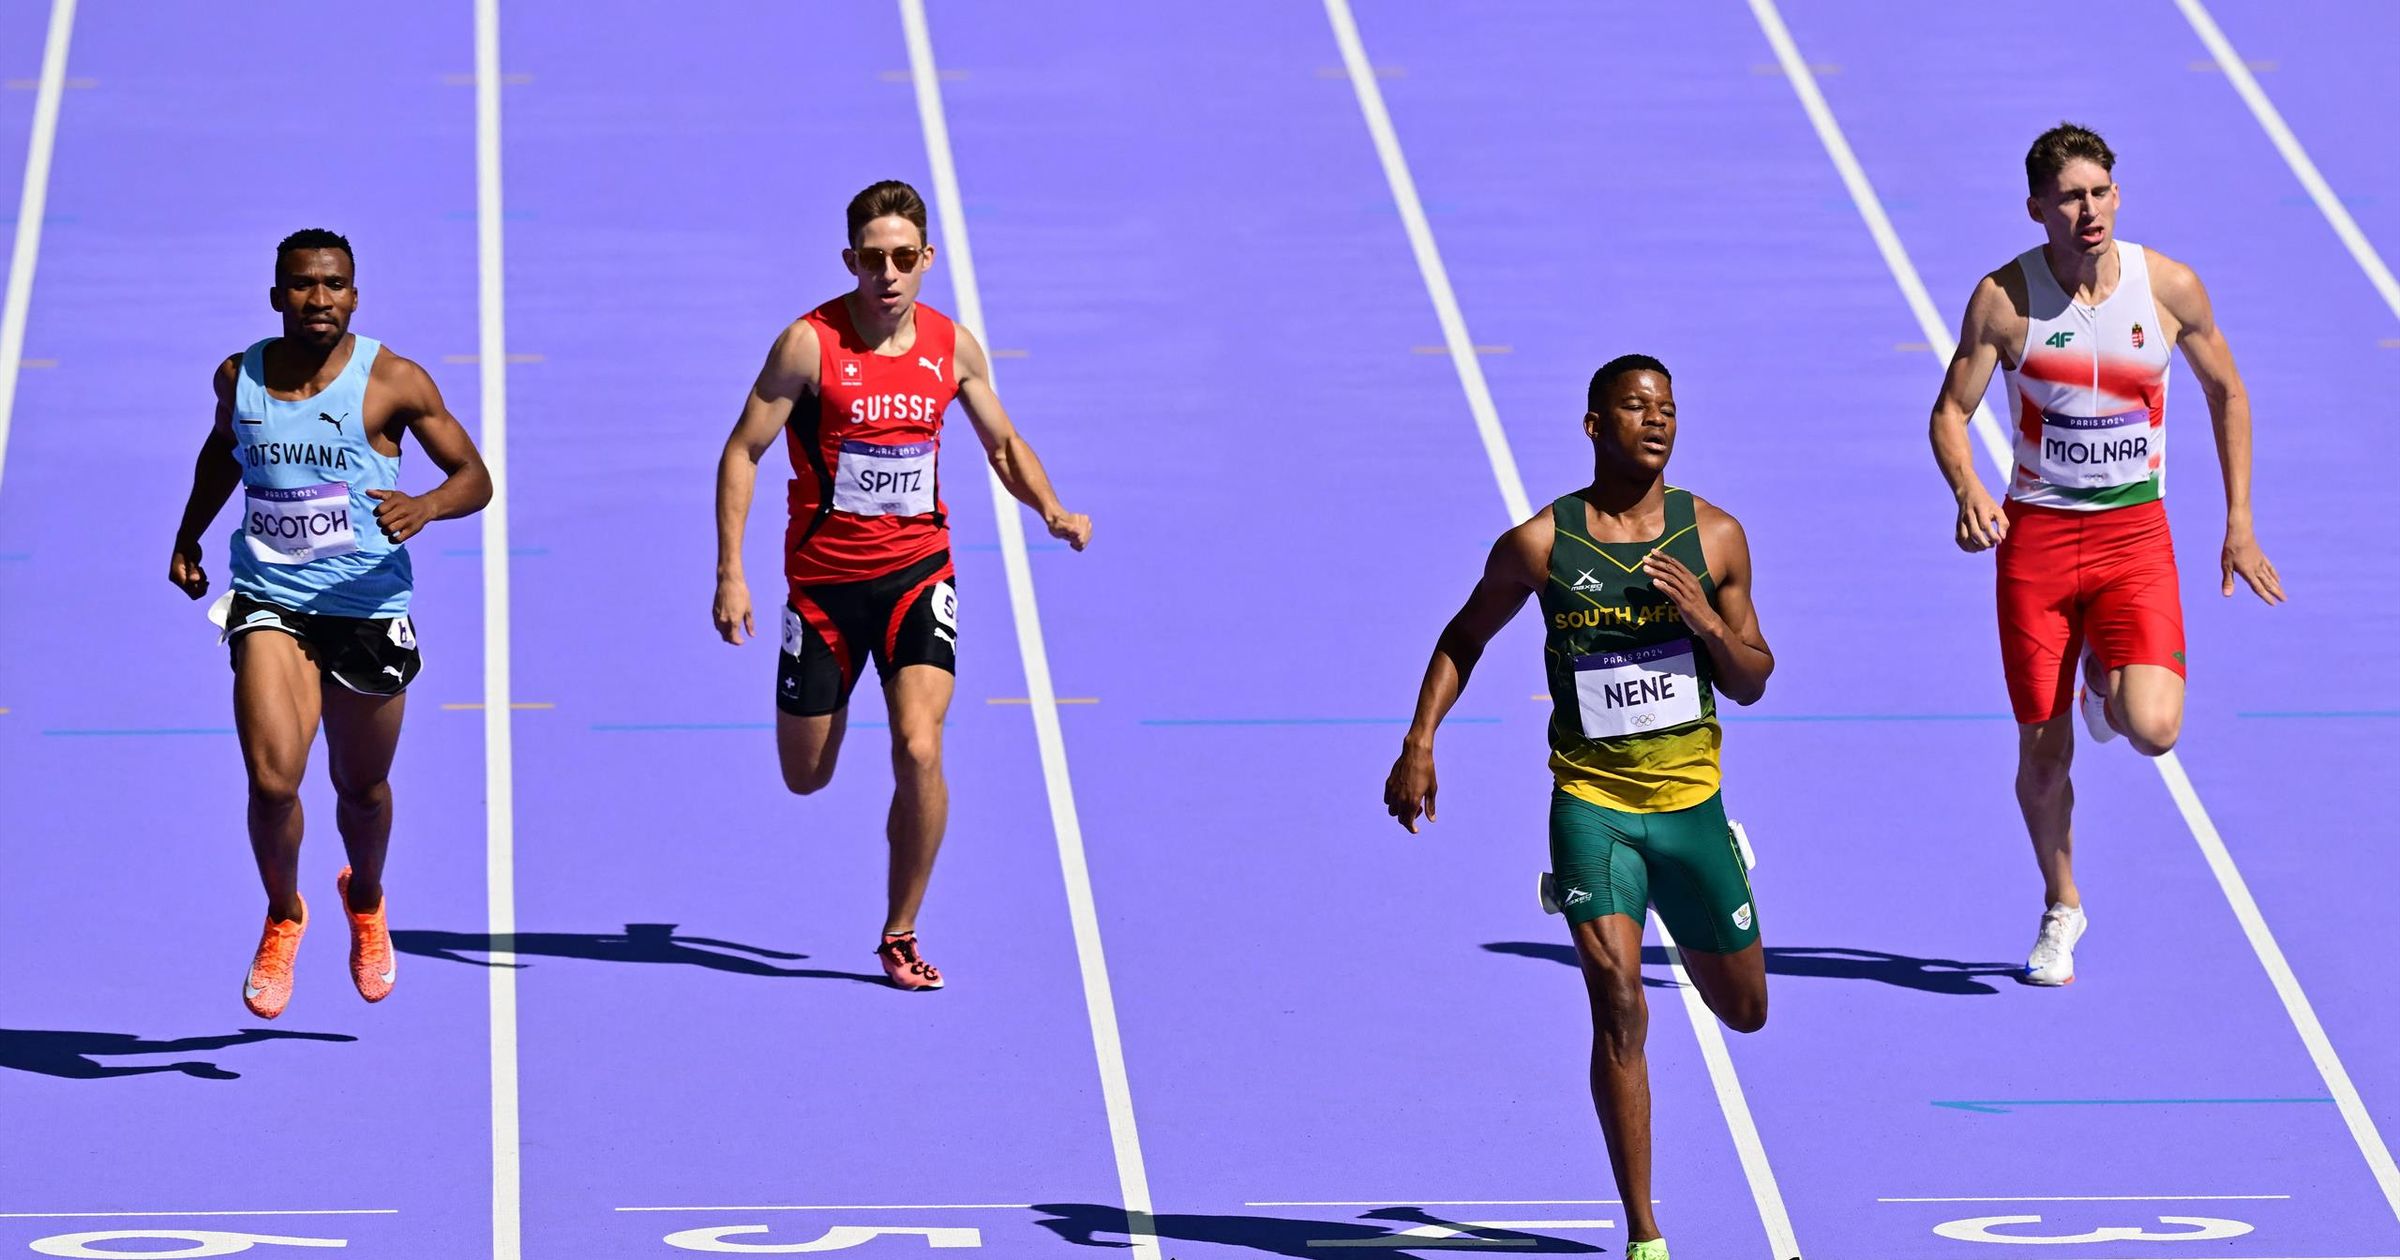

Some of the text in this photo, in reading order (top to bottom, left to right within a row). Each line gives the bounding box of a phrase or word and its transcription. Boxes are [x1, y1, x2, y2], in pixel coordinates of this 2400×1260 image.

[2045, 332, 2075, 348] 4F
[2070, 417, 2124, 426] PARIS 2024
[2045, 437, 2148, 464] MOLNAR
[859, 469, 922, 493] SPITZ
[291, 489, 318, 498] 2024
[250, 510, 348, 538] SCOTCH
[944, 594, 955, 619] 5
[1555, 605, 1681, 629] SOUTH AFR
[1603, 649, 1663, 664] PARIS 2024
[1604, 673, 1675, 709] NENE
[663, 1225, 982, 1253] 5
[1933, 1215, 2255, 1244] 3
